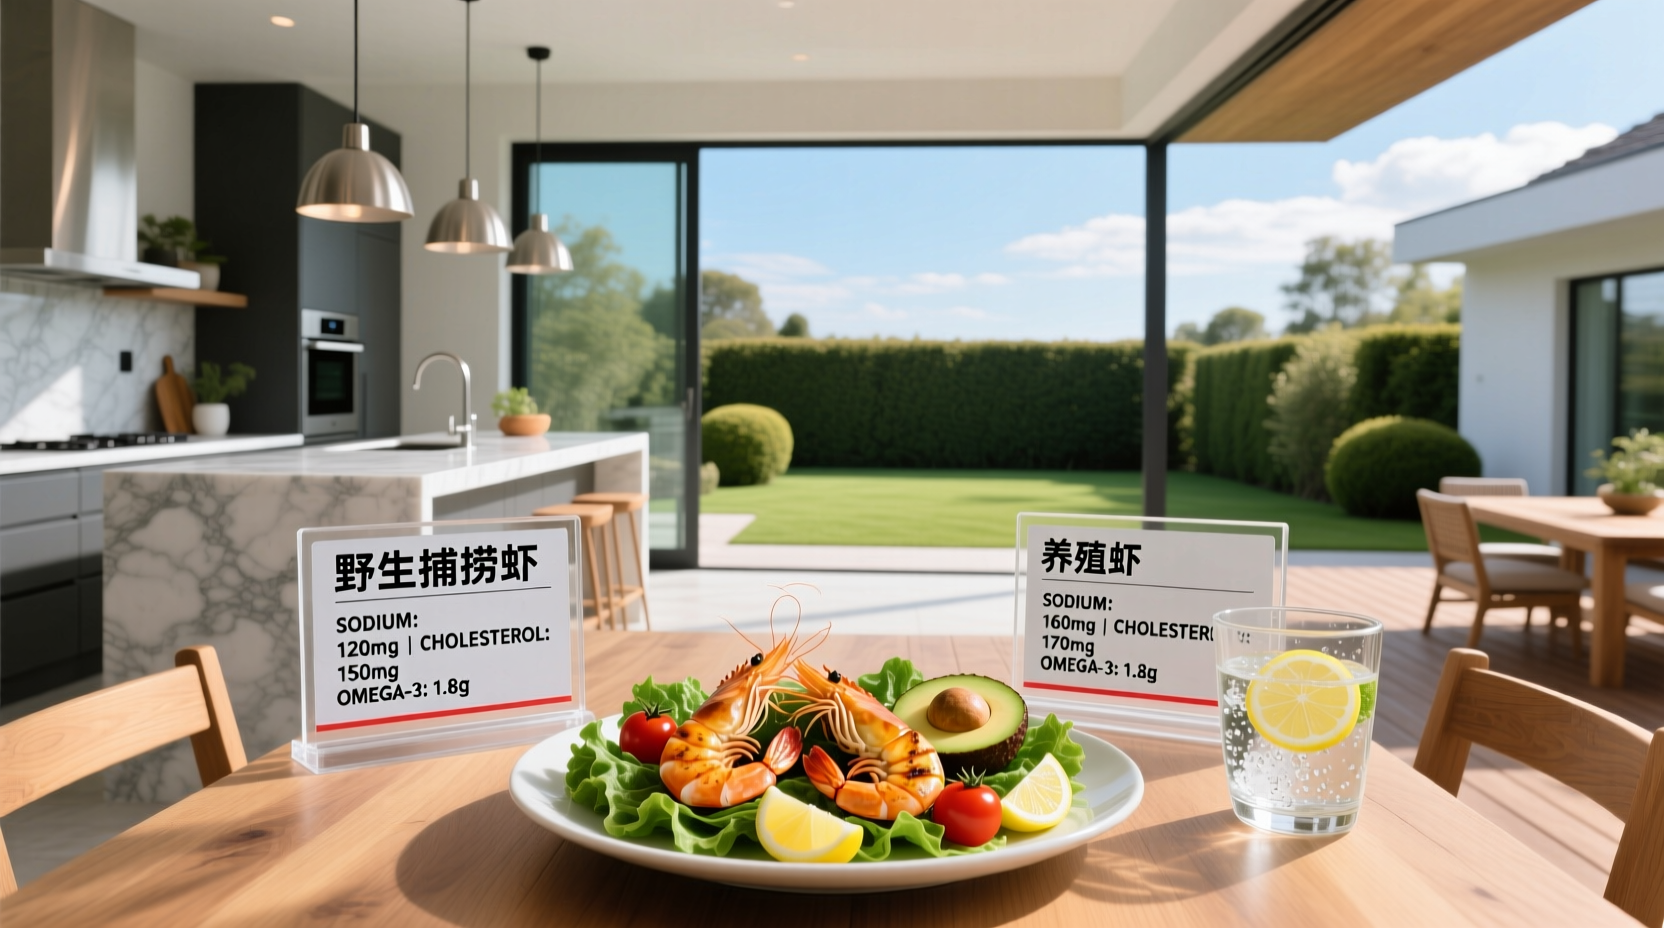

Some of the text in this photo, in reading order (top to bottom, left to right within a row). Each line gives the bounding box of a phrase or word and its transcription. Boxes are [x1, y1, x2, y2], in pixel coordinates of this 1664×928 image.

[334, 543, 538, 593] 野生捕捞虾
[1040, 537, 1142, 577] 养殖虾
[1042, 592, 1113, 611] SODIUM:
[336, 611, 418, 634] SODIUM:
[1042, 614, 1096, 636] 160mg
[337, 639, 399, 659] 120mg
[420, 625, 550, 652] CHOLESTEROL:
[1042, 634, 1095, 658] 170mg
[337, 663, 399, 683] 150mg
[1040, 655, 1158, 684] OMEGA-3: 1.8g
[336, 677, 470, 707] OMEGA-3: 1.8g
